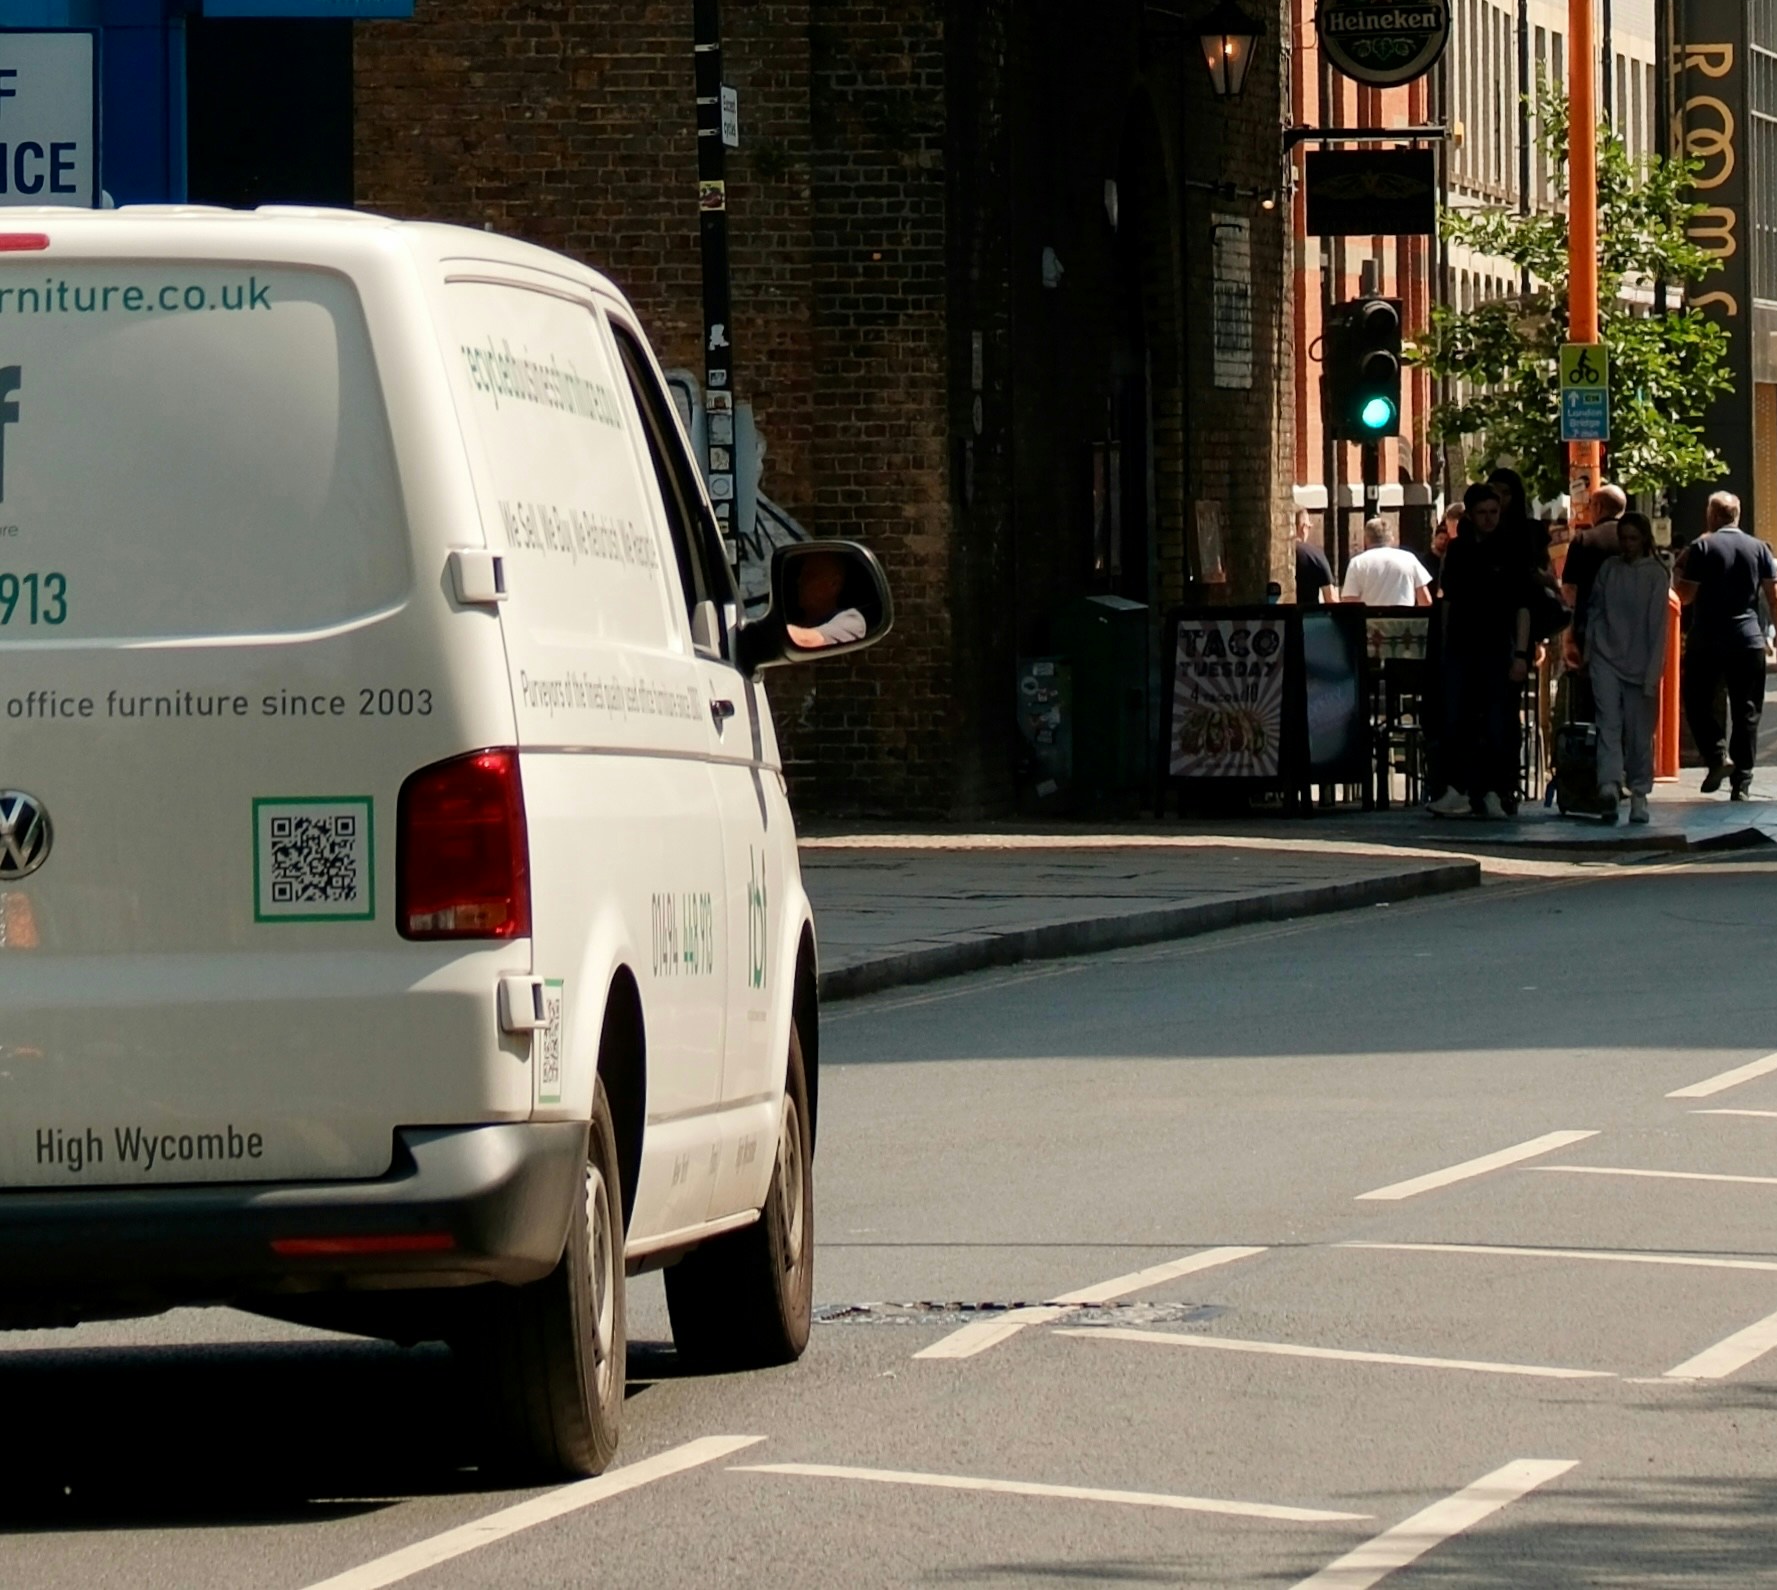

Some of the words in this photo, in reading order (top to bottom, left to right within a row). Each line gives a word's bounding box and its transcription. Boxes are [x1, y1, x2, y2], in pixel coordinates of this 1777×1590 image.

[1329, 9, 1437, 32] Heineken
[1568, 409, 1603, 418] London
[1569, 419, 1600, 428] Bridge
[0, 572, 68, 625] 913
[1179, 629, 1280, 658] TACO
[1179, 661, 1277, 678] TUESDAY
[6, 691, 95, 719] office
[106, 689, 249, 718] furniture
[262, 689, 345, 716] since
[359, 688, 434, 716] 2003
[651, 891, 679, 977] 01494
[36, 1127, 103, 1173] High
[114, 1124, 264, 1172] Wycombe
